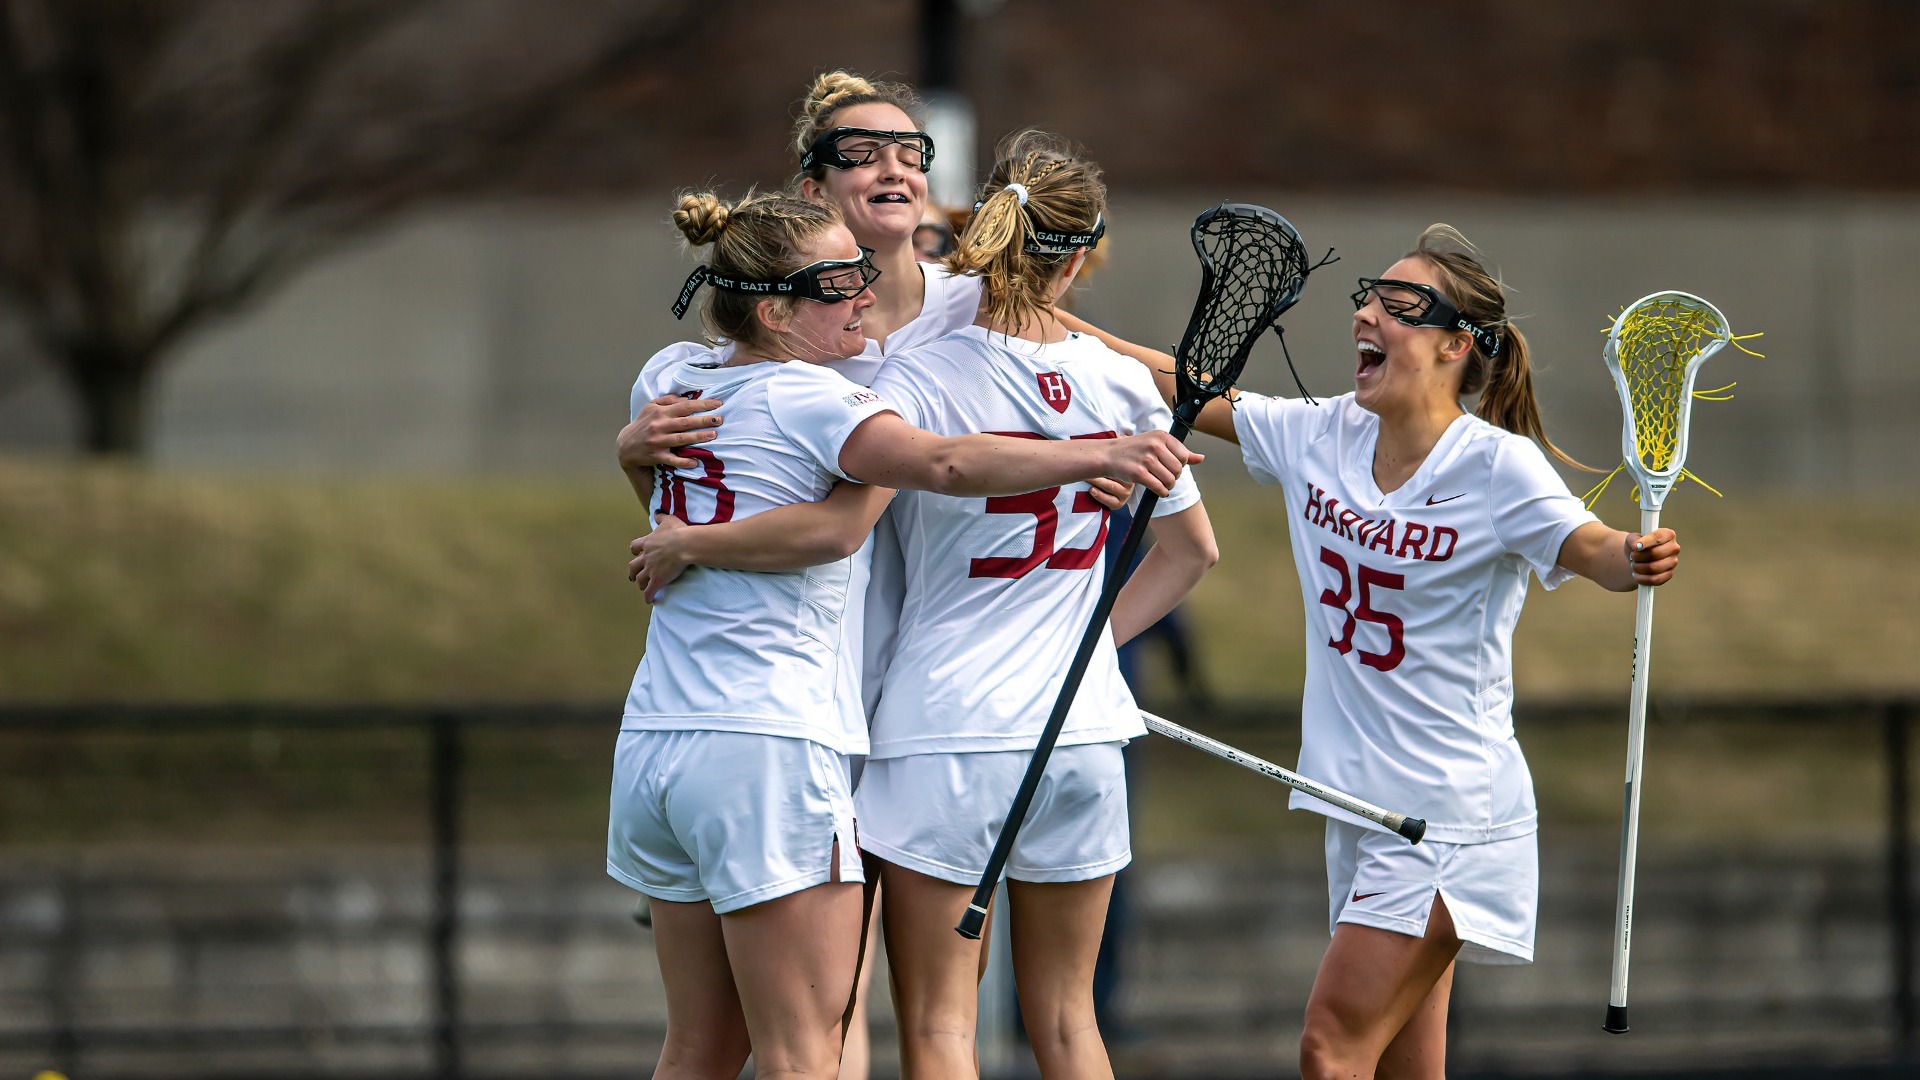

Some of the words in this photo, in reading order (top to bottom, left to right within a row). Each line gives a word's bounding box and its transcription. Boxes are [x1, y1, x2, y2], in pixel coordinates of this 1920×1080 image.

[1037, 232, 1066, 242] GAIT
[687, 271, 703, 291] GAIT
[714, 275, 734, 288] GAIT
[740, 282, 771, 291] GAIT
[1457, 319, 1484, 338] GAIT
[1043, 375, 1066, 401] H
[1304, 482, 1459, 562] HARVARD
[1320, 545, 1406, 672] 35
